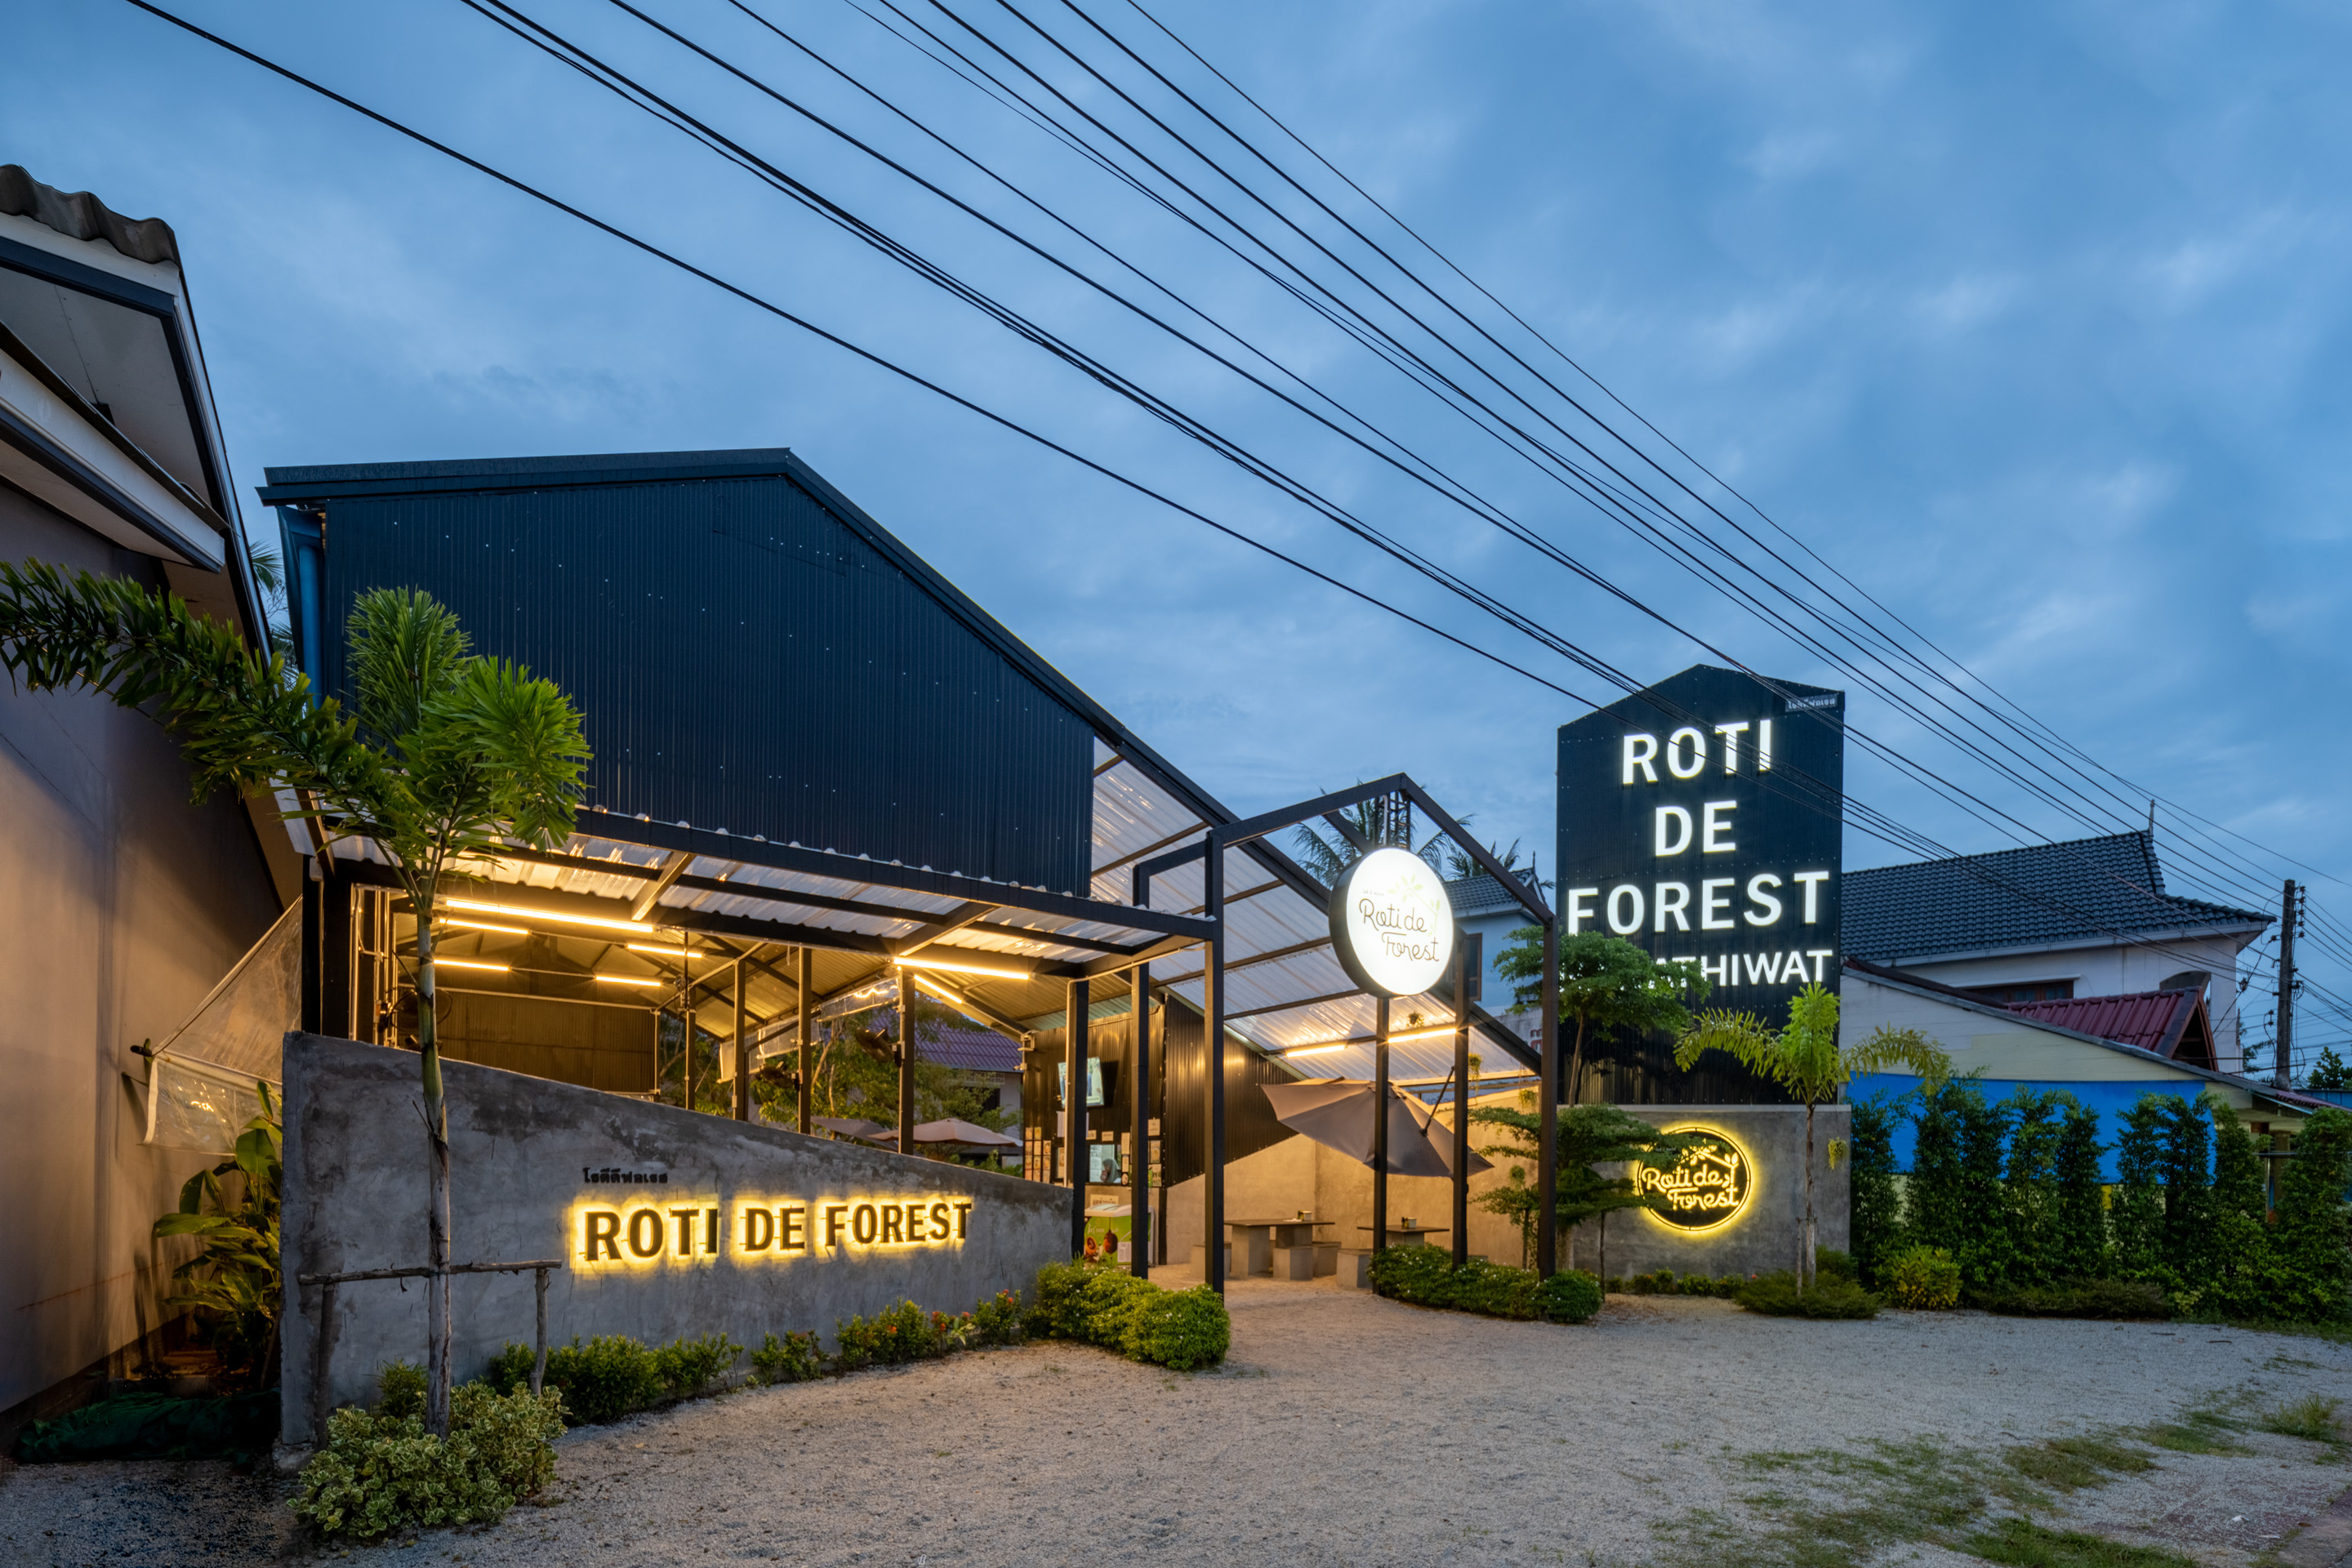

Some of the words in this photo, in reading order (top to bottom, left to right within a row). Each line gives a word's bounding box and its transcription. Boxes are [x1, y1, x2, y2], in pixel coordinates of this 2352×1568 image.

[1622, 719, 1772, 786] ROTI
[1655, 800, 1738, 858] DE
[1359, 898, 1402, 932] Roti
[1404, 907, 1428, 933] de
[1567, 871, 1830, 936] FOREST
[1381, 932, 1440, 962] Forest
[1642, 1165, 1694, 1193] Roti
[1693, 1164, 1723, 1187] de
[1667, 1184, 1740, 1211] Forest
[585, 1208, 718, 1261] ROTI
[745, 1206, 805, 1251] DE
[826, 1201, 972, 1247] FOREST
